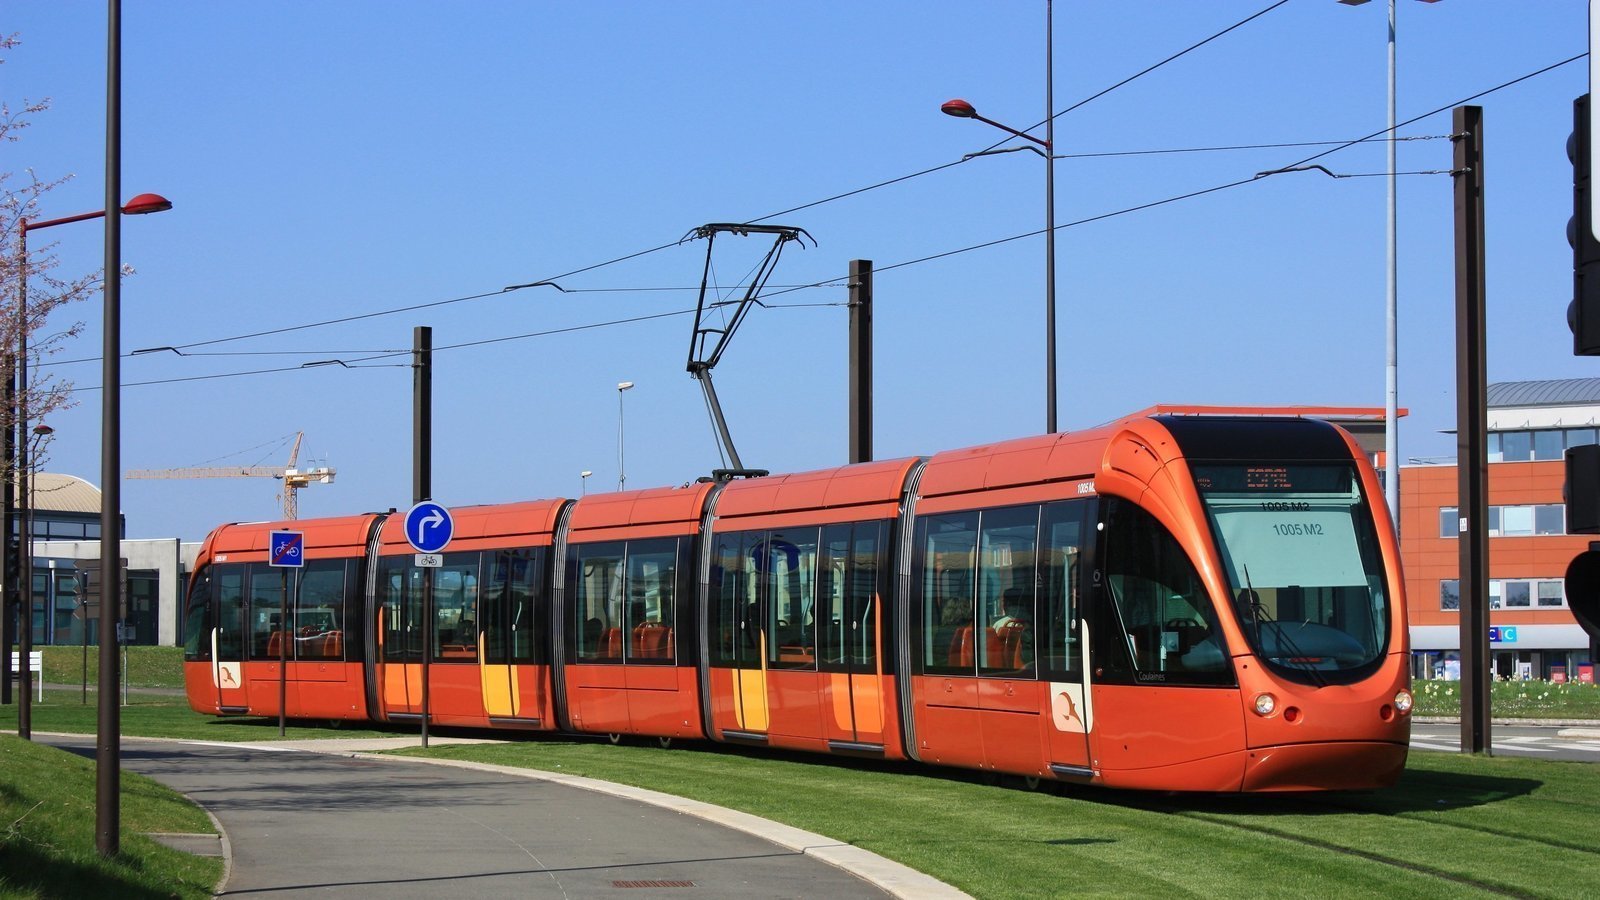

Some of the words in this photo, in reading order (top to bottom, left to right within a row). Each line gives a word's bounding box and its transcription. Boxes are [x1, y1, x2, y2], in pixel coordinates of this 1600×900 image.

[1260, 501, 1290, 511] 1005
[1290, 501, 1311, 511] M2
[1273, 523, 1303, 536] 1005
[1303, 523, 1325, 536] M2
